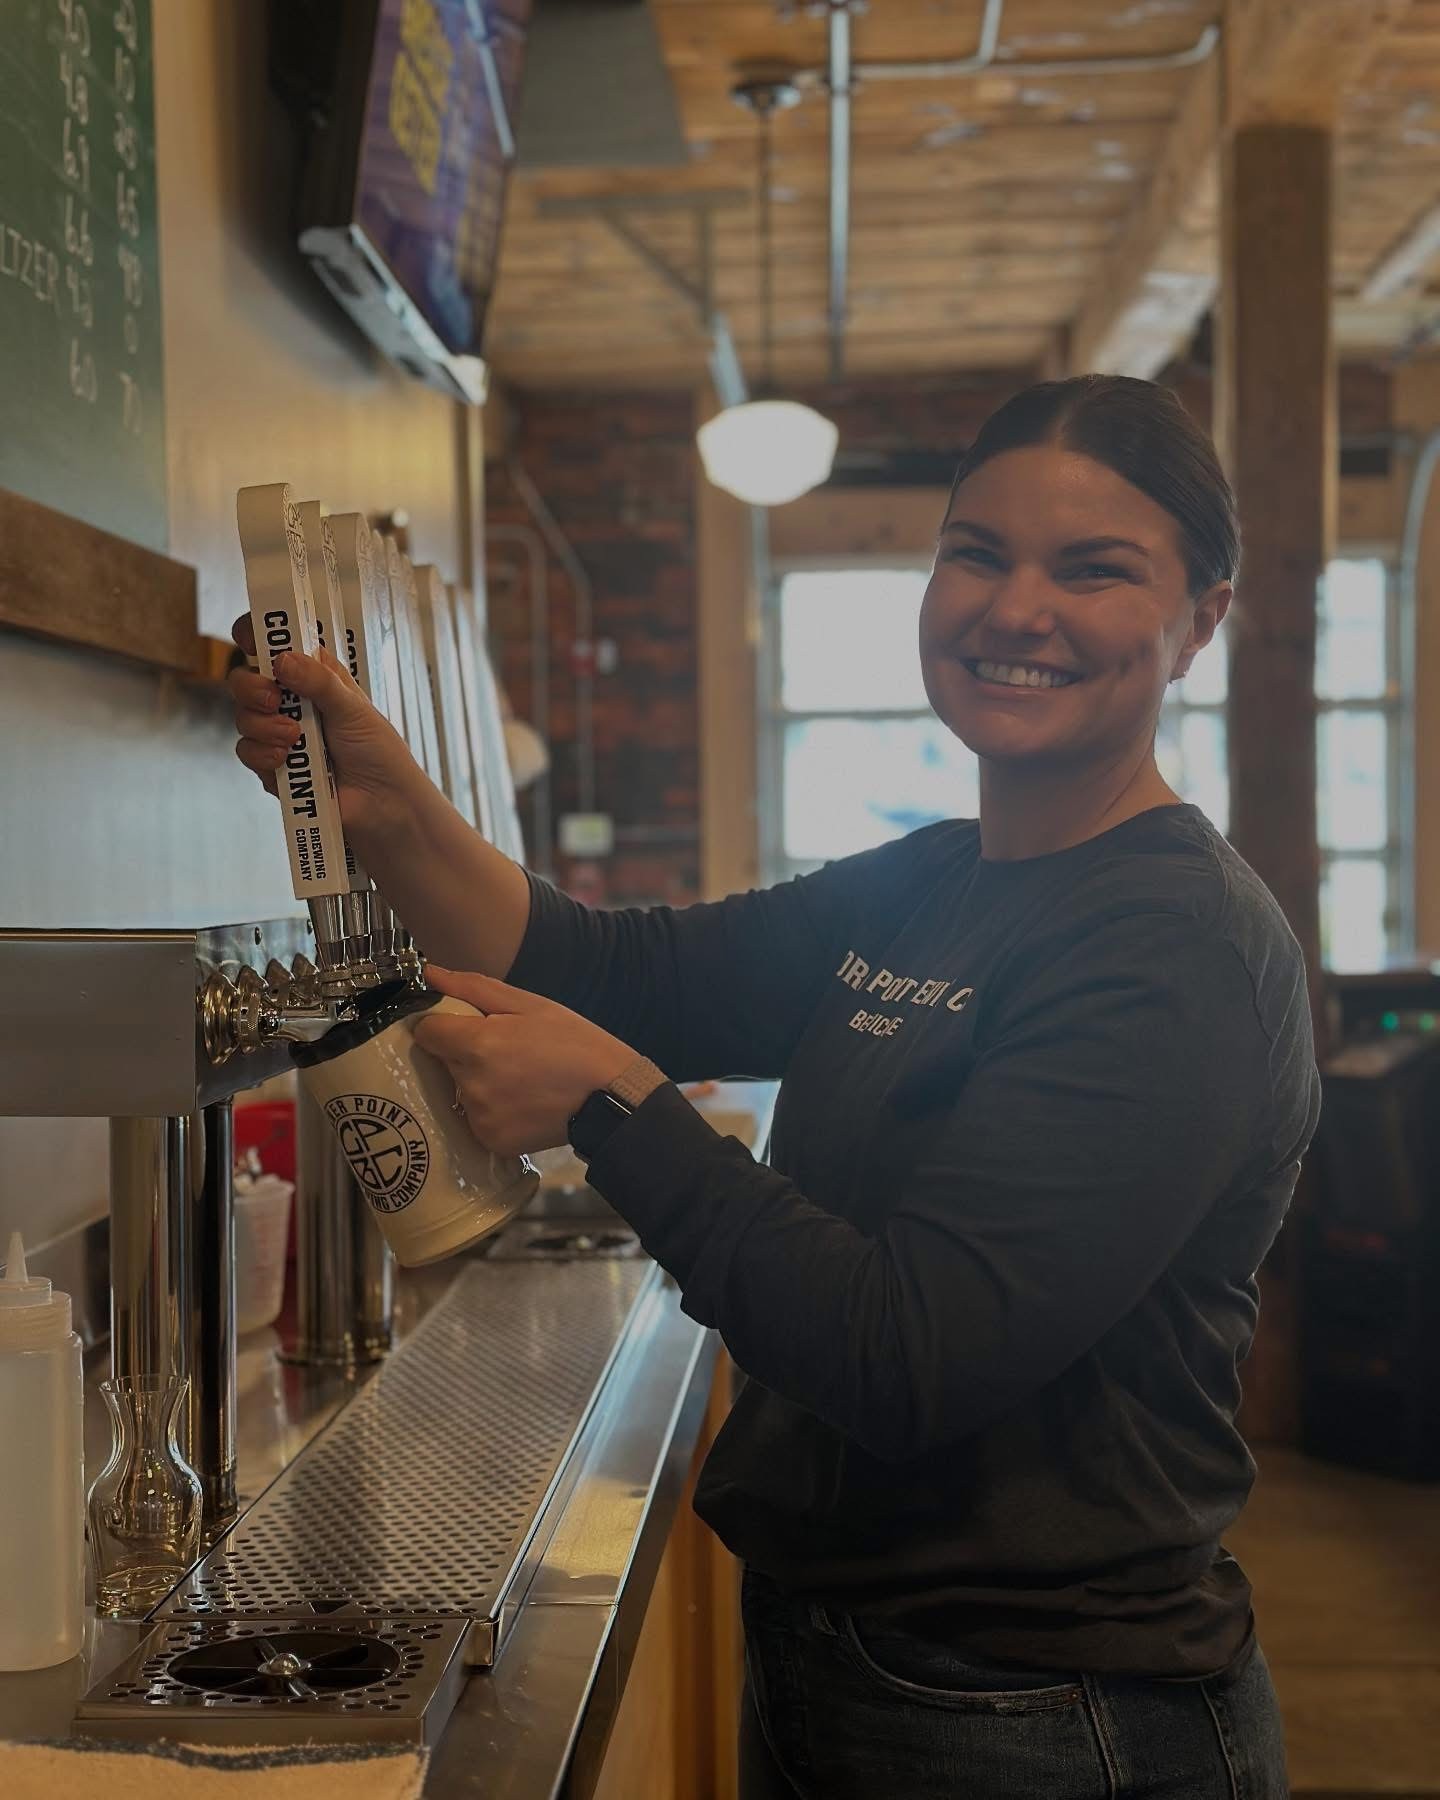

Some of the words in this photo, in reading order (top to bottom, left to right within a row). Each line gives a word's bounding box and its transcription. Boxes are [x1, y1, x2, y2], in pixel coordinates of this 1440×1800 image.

[295, 828, 313, 882] COMPANY
[309, 827, 327, 880] BREWING
[353, 1096, 414, 1130] POINT
[390, 1138, 427, 1209] COMPANY
